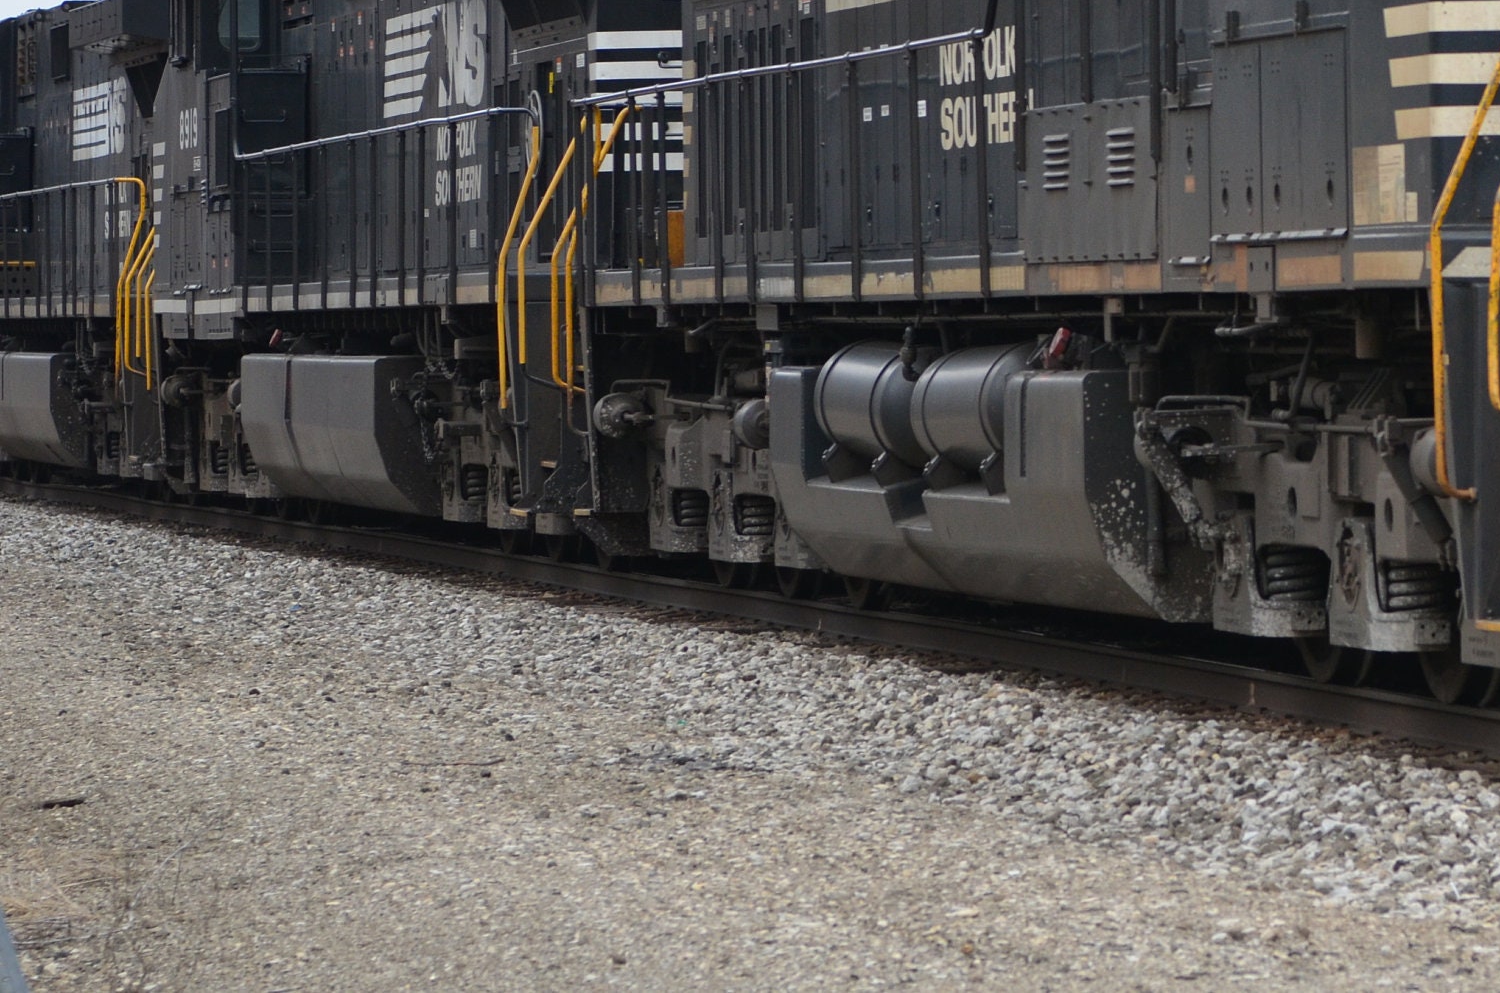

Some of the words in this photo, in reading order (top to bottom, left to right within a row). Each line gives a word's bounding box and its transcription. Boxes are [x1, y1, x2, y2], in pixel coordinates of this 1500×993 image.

[939, 25, 1016, 86] NOROLK
[179, 107, 198, 151] 8919
[436, 118, 477, 162] NOFOLK
